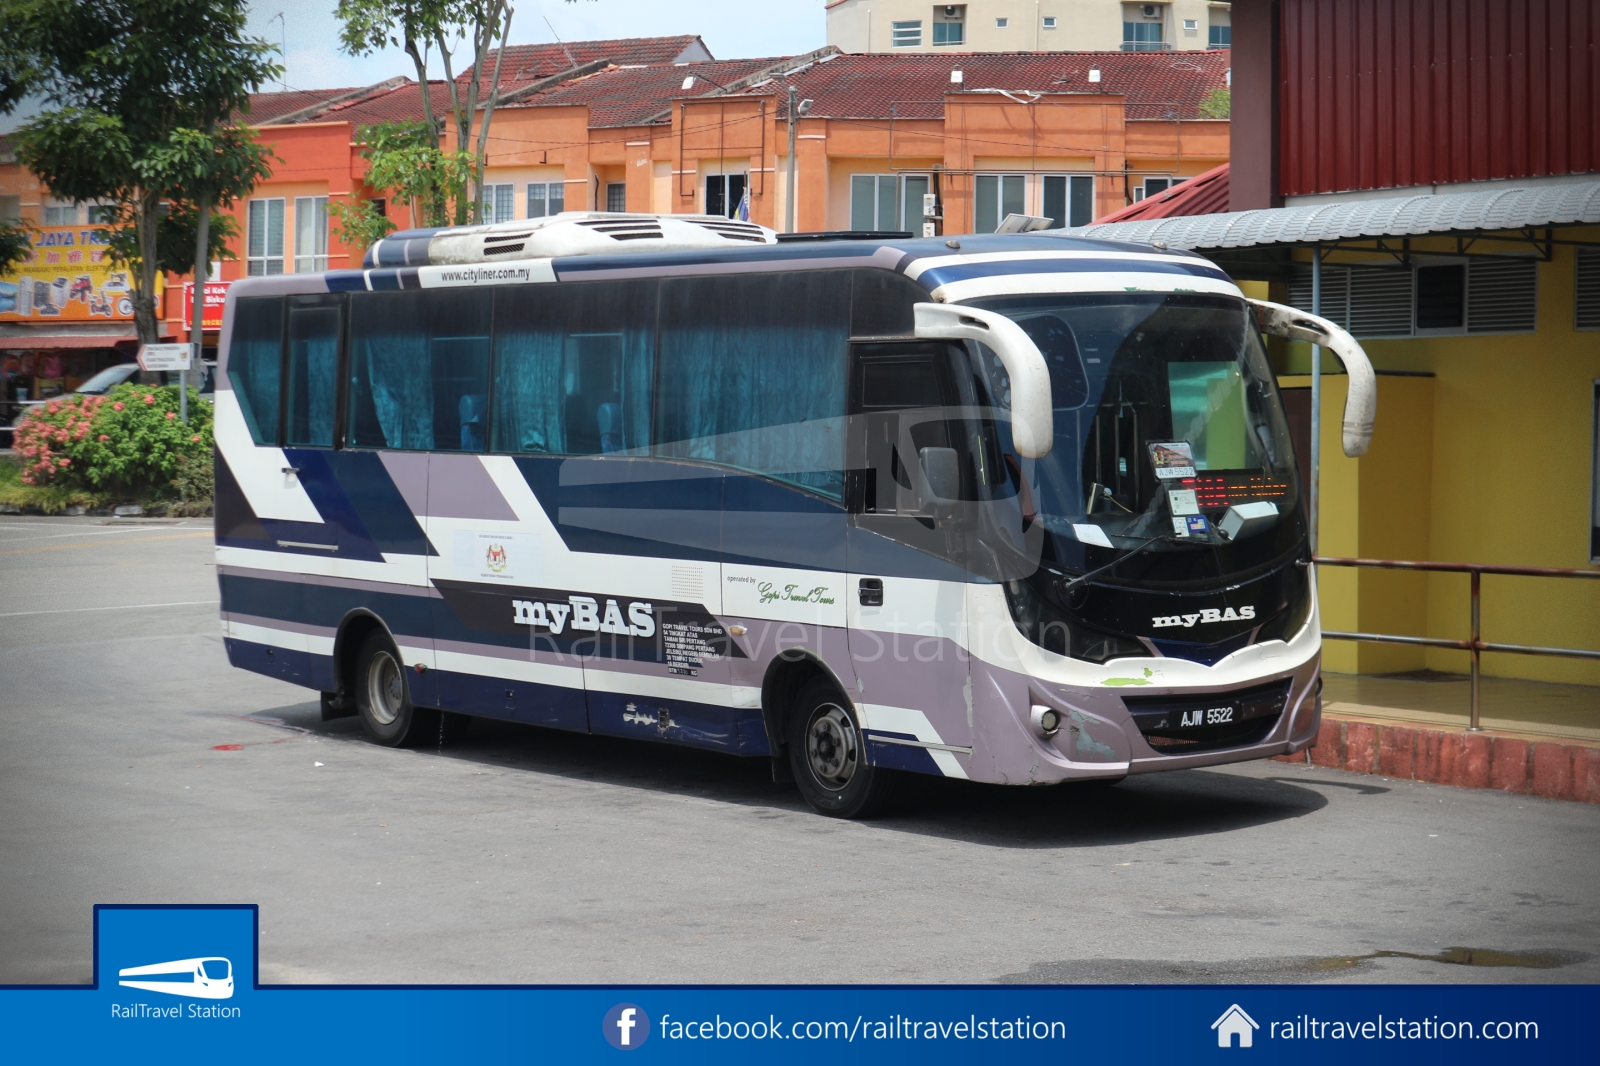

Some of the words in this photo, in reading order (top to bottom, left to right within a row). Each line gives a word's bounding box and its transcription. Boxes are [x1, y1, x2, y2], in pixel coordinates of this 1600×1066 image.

[35, 231, 75, 247] JAYA
[441, 268, 530, 284] www.cityliner.com.my
[206, 295, 226, 304] Bisku
[727, 576, 749, 584] operated
[749, 577, 756, 585] by
[758, 581, 780, 604] Gopi
[810, 586, 835, 605] Tours
[512, 595, 656, 638] myBAS
[1152, 605, 1256, 628] myBAS
[676, 643, 695, 651] SIMPANG
[695, 645, 716, 653] PERTANG
[1180, 710, 1203, 727] AJW
[1206, 707, 1233, 724] 5522
